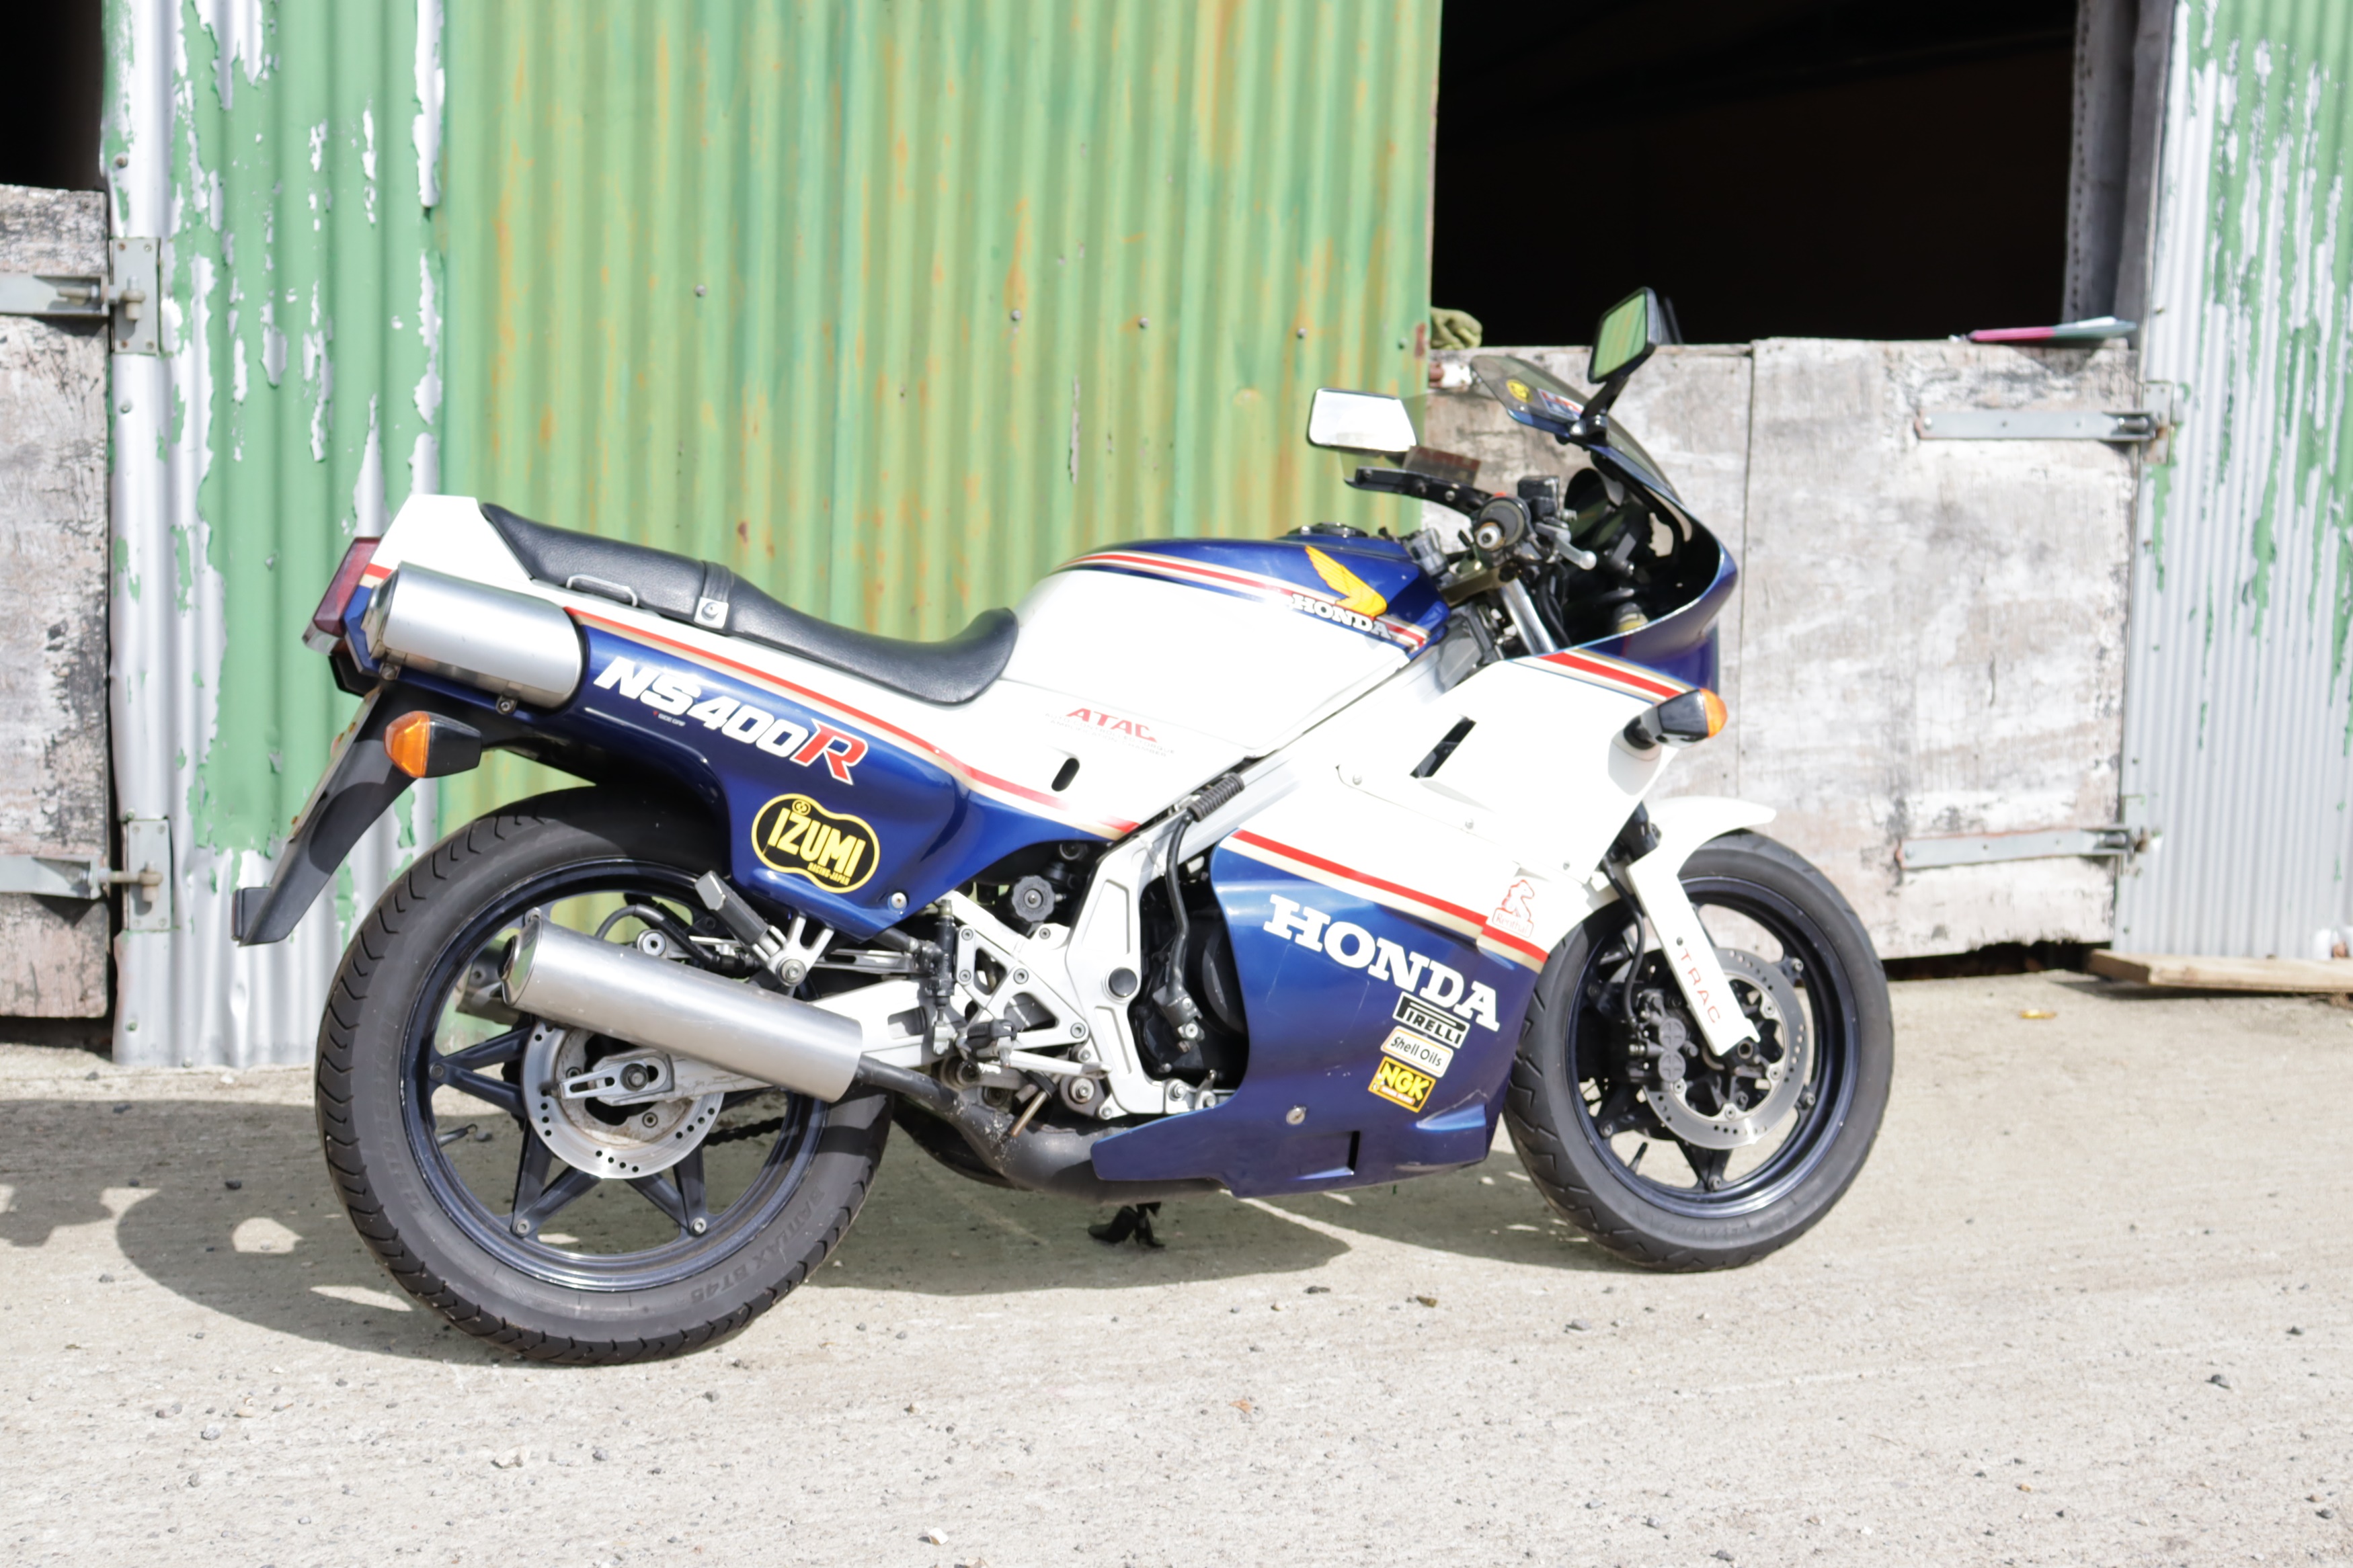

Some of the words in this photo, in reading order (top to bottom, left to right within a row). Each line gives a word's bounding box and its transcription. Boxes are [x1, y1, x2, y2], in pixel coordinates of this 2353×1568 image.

[1291, 593, 1392, 639] HONDA
[594, 656, 868, 785] NS400R
[1066, 708, 1158, 743] ATAC
[768, 807, 866, 878] IZUMI
[1263, 894, 1501, 1032] HONDA
[1681, 948, 1720, 1024] TRAC
[1396, 995, 1466, 1044] PIRELLI
[1391, 1036, 1420, 1056] Shell
[1420, 1048, 1442, 1067] Oils
[1379, 1062, 1430, 1101] NGK
[688, 1263, 752, 1305] BT45
